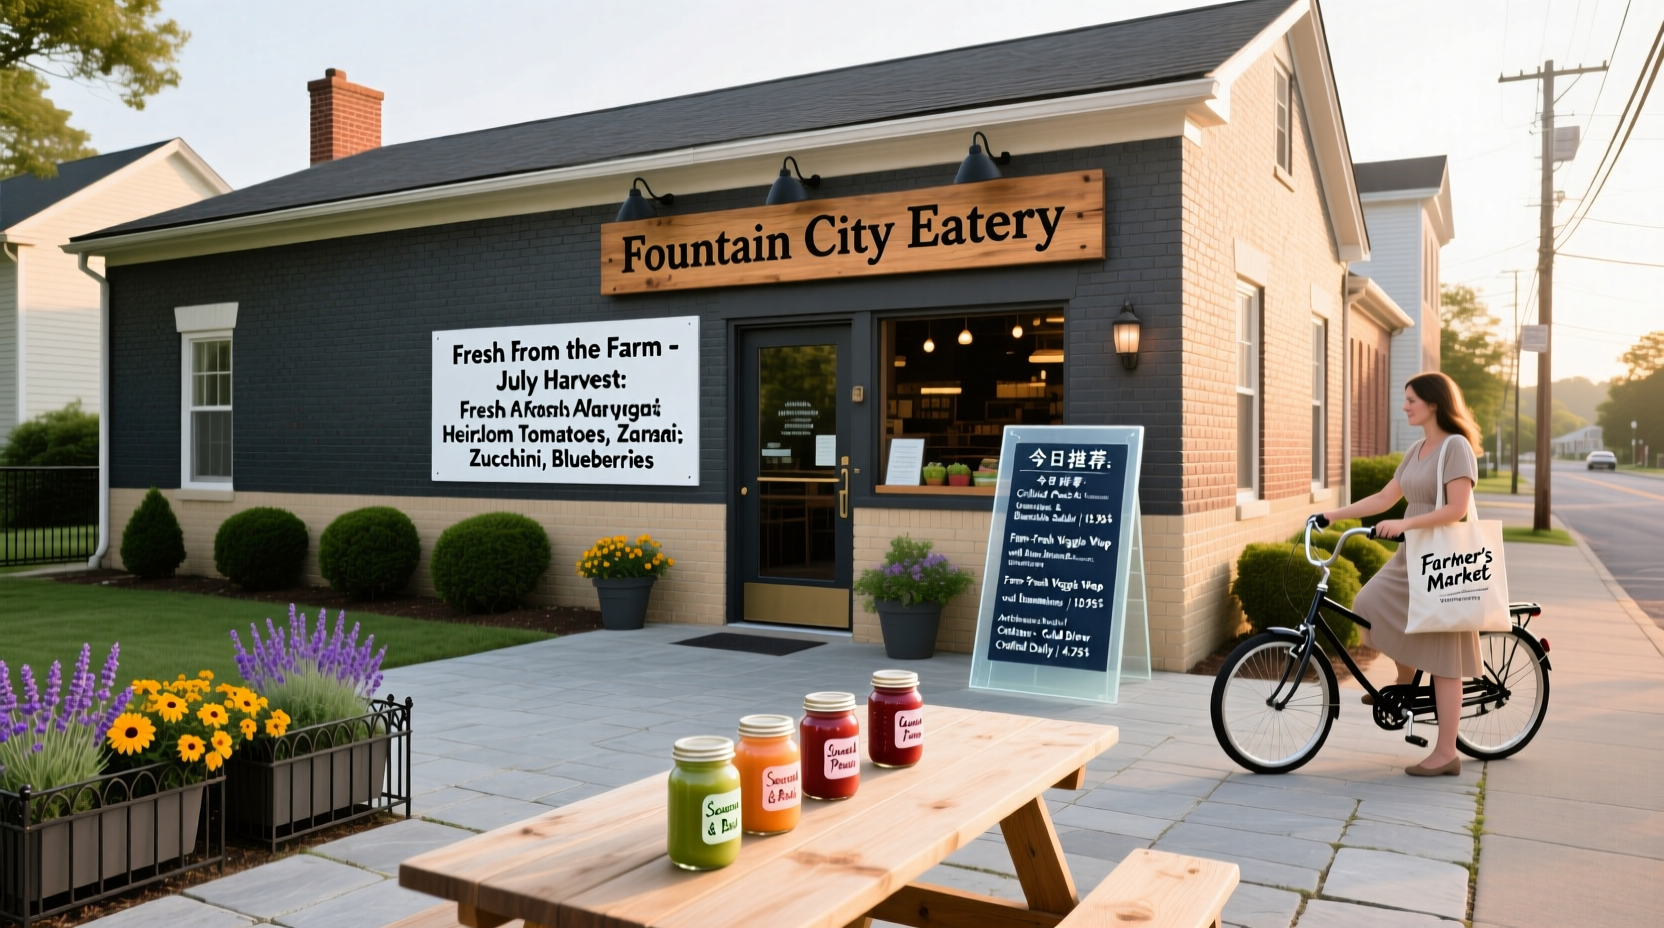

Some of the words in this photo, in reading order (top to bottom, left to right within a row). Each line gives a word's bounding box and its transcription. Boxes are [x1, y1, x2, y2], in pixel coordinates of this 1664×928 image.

[622, 223, 792, 273] Fountain
[804, 214, 896, 266] City
[907, 203, 1065, 252] Eatery
[453, 341, 506, 365] Fresh
[511, 340, 560, 362] From
[566, 337, 601, 360] the
[607, 336, 662, 359] Farm
[496, 369, 539, 396] July
[544, 369, 627, 390] Harvest:
[460, 399, 506, 419] Fresh
[518, 424, 611, 446] Tomatoes,
[469, 448, 547, 471] Zucchini,
[552, 448, 654, 469] Blueberries
[1421, 547, 1493, 575] Farmer's
[1427, 564, 1491, 592] Market
